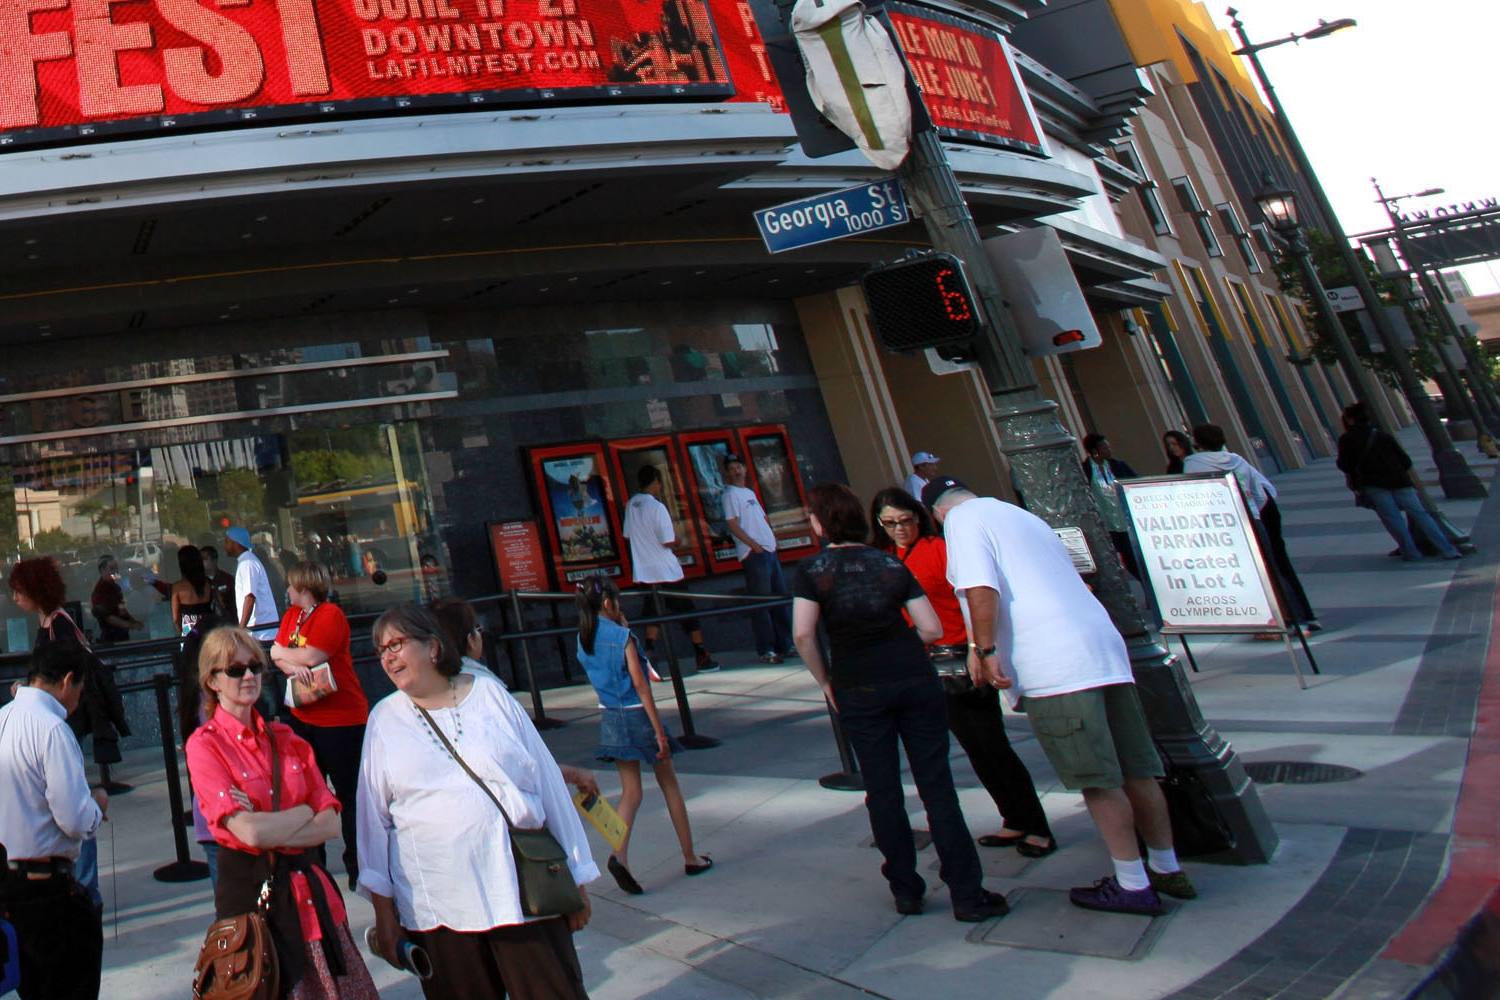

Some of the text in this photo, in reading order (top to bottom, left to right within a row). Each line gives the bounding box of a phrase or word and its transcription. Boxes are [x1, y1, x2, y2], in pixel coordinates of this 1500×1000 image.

[362, 19, 596, 58] DOWNTOWN
[921, 24, 963, 64] MAY
[960, 35, 983, 69] 10
[366, 49, 601, 81] LAFILMFEST.COM
[944, 64, 989, 105] JUNE
[982, 75, 998, 108] 1
[763, 183, 896, 235] Georgia St
[843, 205, 904, 233] 1000 S
[1142, 490, 1223, 503] REGAL CINEMAS
[1136, 512, 1236, 532] VALIDATED
[1150, 531, 1234, 550] PARKING
[1158, 552, 1240, 571] Located
[1166, 572, 1245, 590] In Lot 4
[1186, 595, 1236, 606] ACROSS
[1170, 605, 1261, 617] OLYMPIC BLVD.
